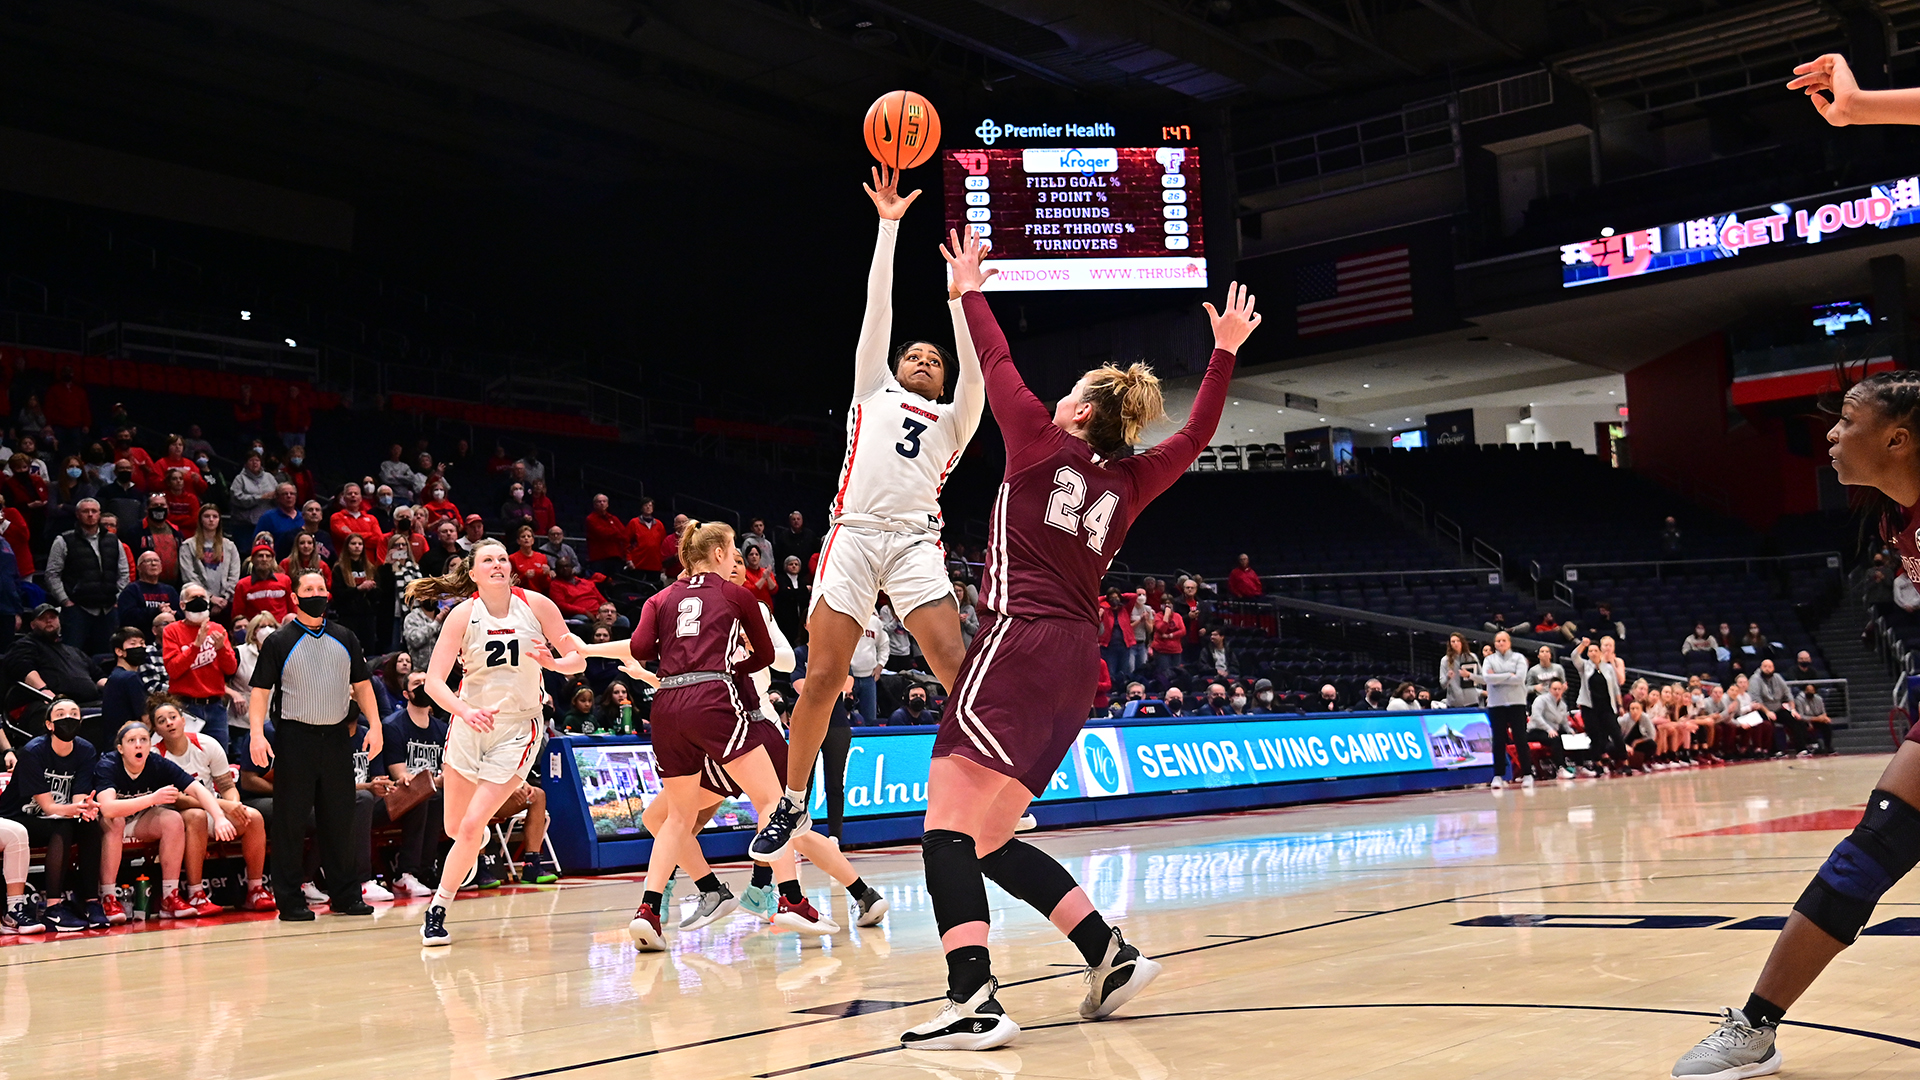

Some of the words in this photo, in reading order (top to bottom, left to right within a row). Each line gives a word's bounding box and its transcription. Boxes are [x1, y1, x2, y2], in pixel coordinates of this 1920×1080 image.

[1004, 122, 1063, 138] Premier
[1065, 122, 1116, 138] Health
[1162, 125, 1191, 140] 1:47
[1060, 148, 1110, 177] Kroger
[970, 179, 984, 187] 33
[1026, 177, 1067, 188] FIELD
[1070, 176, 1107, 188] GOAL
[1109, 176, 1121, 187] %
[972, 195, 983, 203] 21
[1038, 192, 1047, 203] 3
[1050, 191, 1093, 203] POINT
[1096, 191, 1108, 202] %
[972, 210, 985, 218] 37
[1035, 207, 1110, 219] REBOUNDS
[1169, 208, 1180, 216] 41
[1024, 223, 1061, 235] FREE
[1063, 223, 1124, 234] THROWS
[1720, 213, 1789, 250] GET
[1795, 197, 1894, 238] LOUD
[1033, 238, 1119, 250] TURNOVERS
[1173, 238, 1180, 246] 7
[997, 269, 1070, 281] WINDOWS
[1089, 268, 1207, 279] WWW.THRUSHA
[900, 402, 940, 423] DAYTON
[895, 416, 928, 460] 3
[1044, 465, 1120, 556] 24
[676, 596, 703, 638] 2
[485, 638, 519, 667] 21
[1136, 740, 1245, 778] SENIOR
[1243, 737, 1329, 770] LIVING
[1330, 731, 1422, 764] CAMPUS
